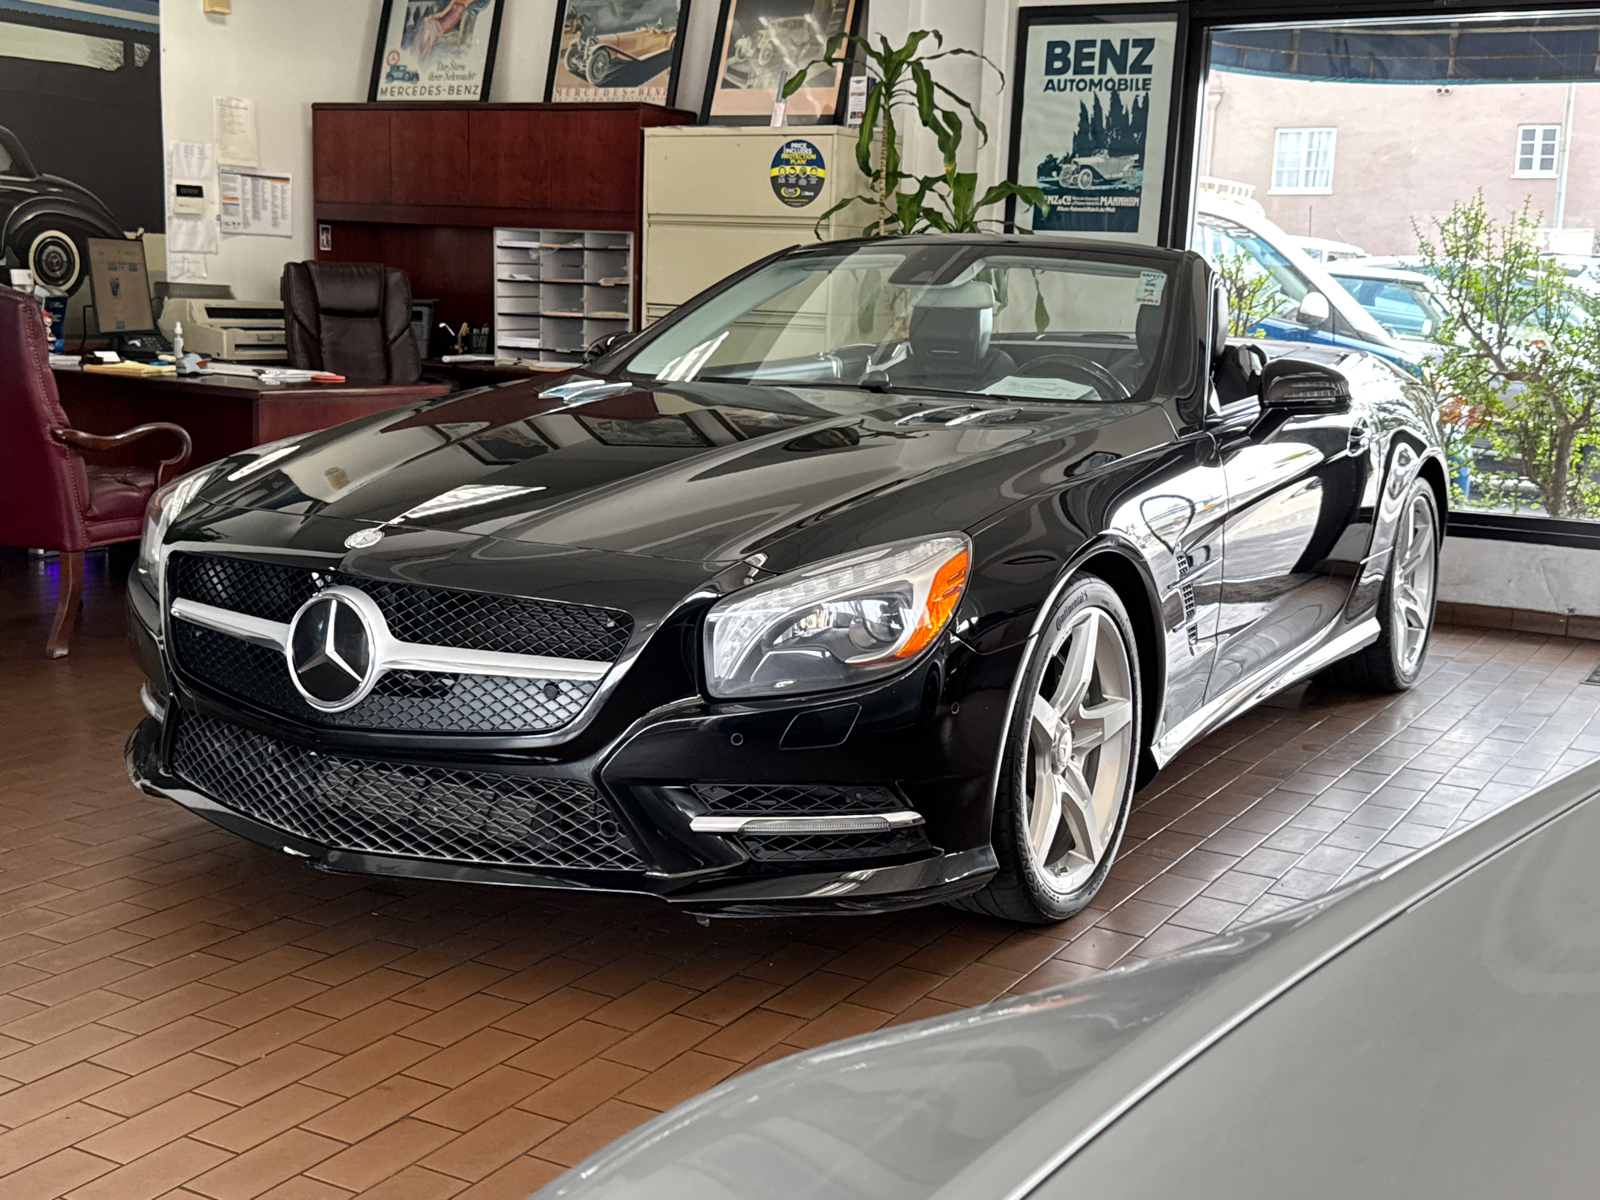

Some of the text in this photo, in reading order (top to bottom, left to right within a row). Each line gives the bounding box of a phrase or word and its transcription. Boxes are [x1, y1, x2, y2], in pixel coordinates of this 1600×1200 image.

[1044, 38, 1156, 76] BENZ
[379, 84, 480, 97] MERCEDES-BENZ
[1043, 77, 1153, 93] AUTOMOBILE
